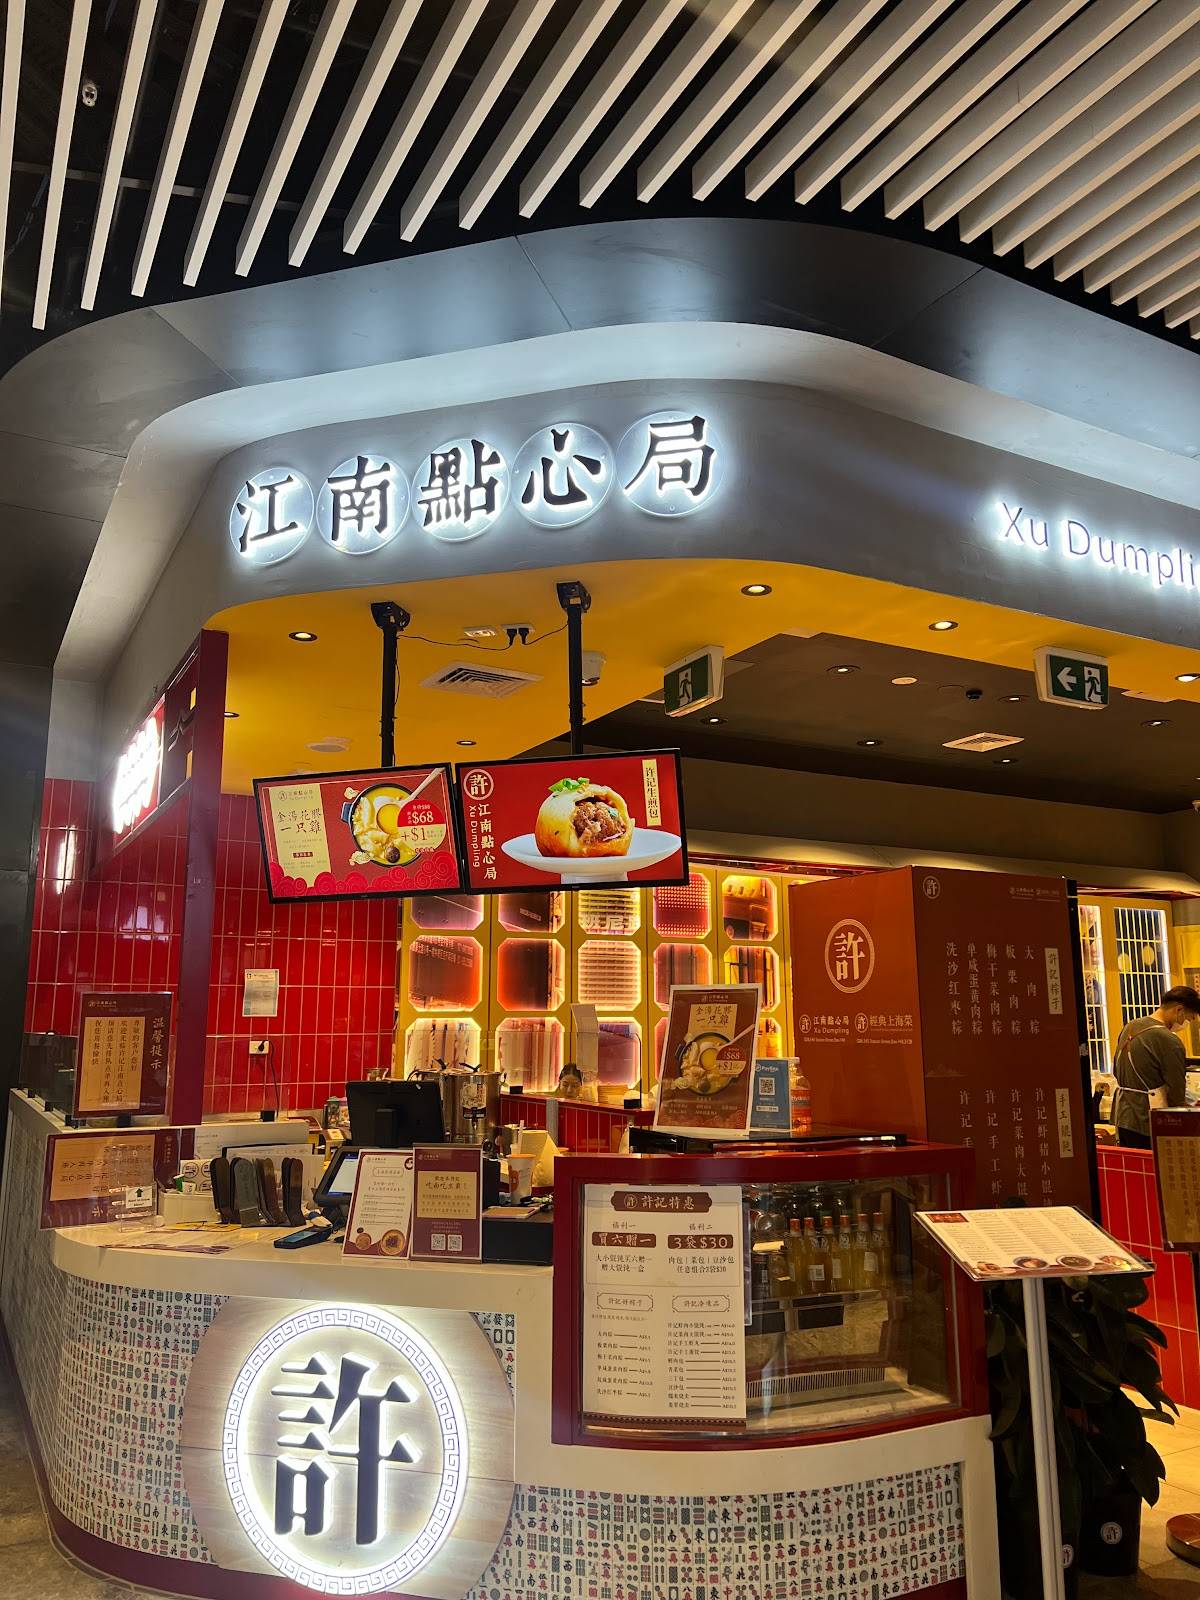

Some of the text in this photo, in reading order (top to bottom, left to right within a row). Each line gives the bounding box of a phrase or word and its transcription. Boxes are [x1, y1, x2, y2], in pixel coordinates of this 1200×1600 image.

[237, 415, 715, 553] 江南點心局
[1002, 502, 1048, 547] Xu
[469, 774, 488, 795] 許
[401, 827, 427, 841] +$1
[412, 811, 434, 824] $68
[469, 805, 480, 868] Xu Dumpling
[478, 803, 497, 880] 江南點心局
[833, 932, 866, 981] 許
[271, 1355, 415, 1545] 許
